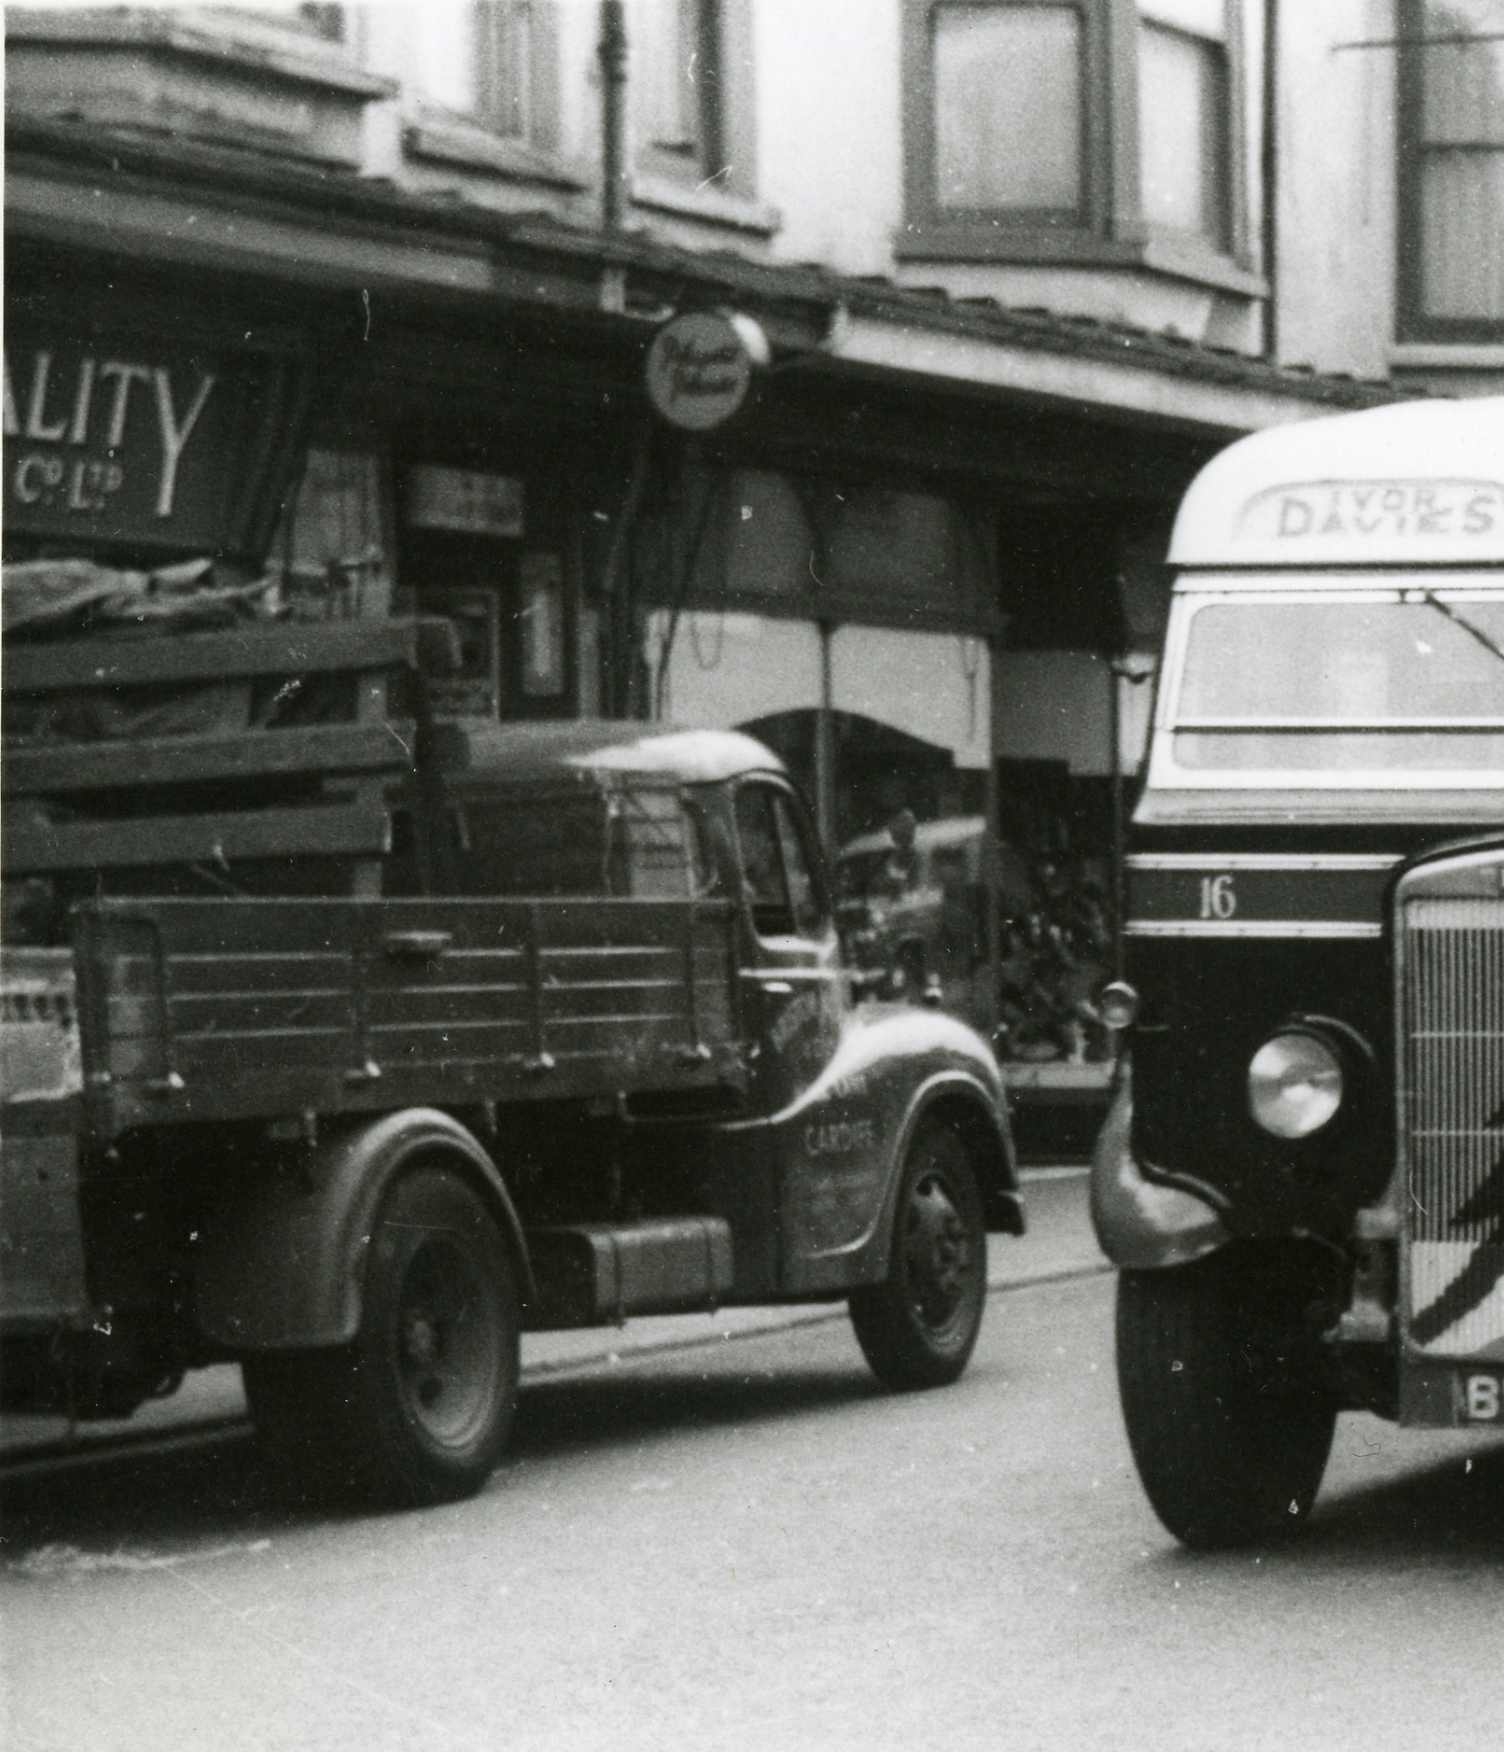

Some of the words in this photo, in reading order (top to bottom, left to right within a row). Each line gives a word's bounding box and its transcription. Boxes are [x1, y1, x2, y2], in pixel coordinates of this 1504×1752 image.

[1277, 495, 1497, 538] DAVIES
[1332, 488, 1438, 513] IVOR
[1200, 875, 1236, 919] 16
